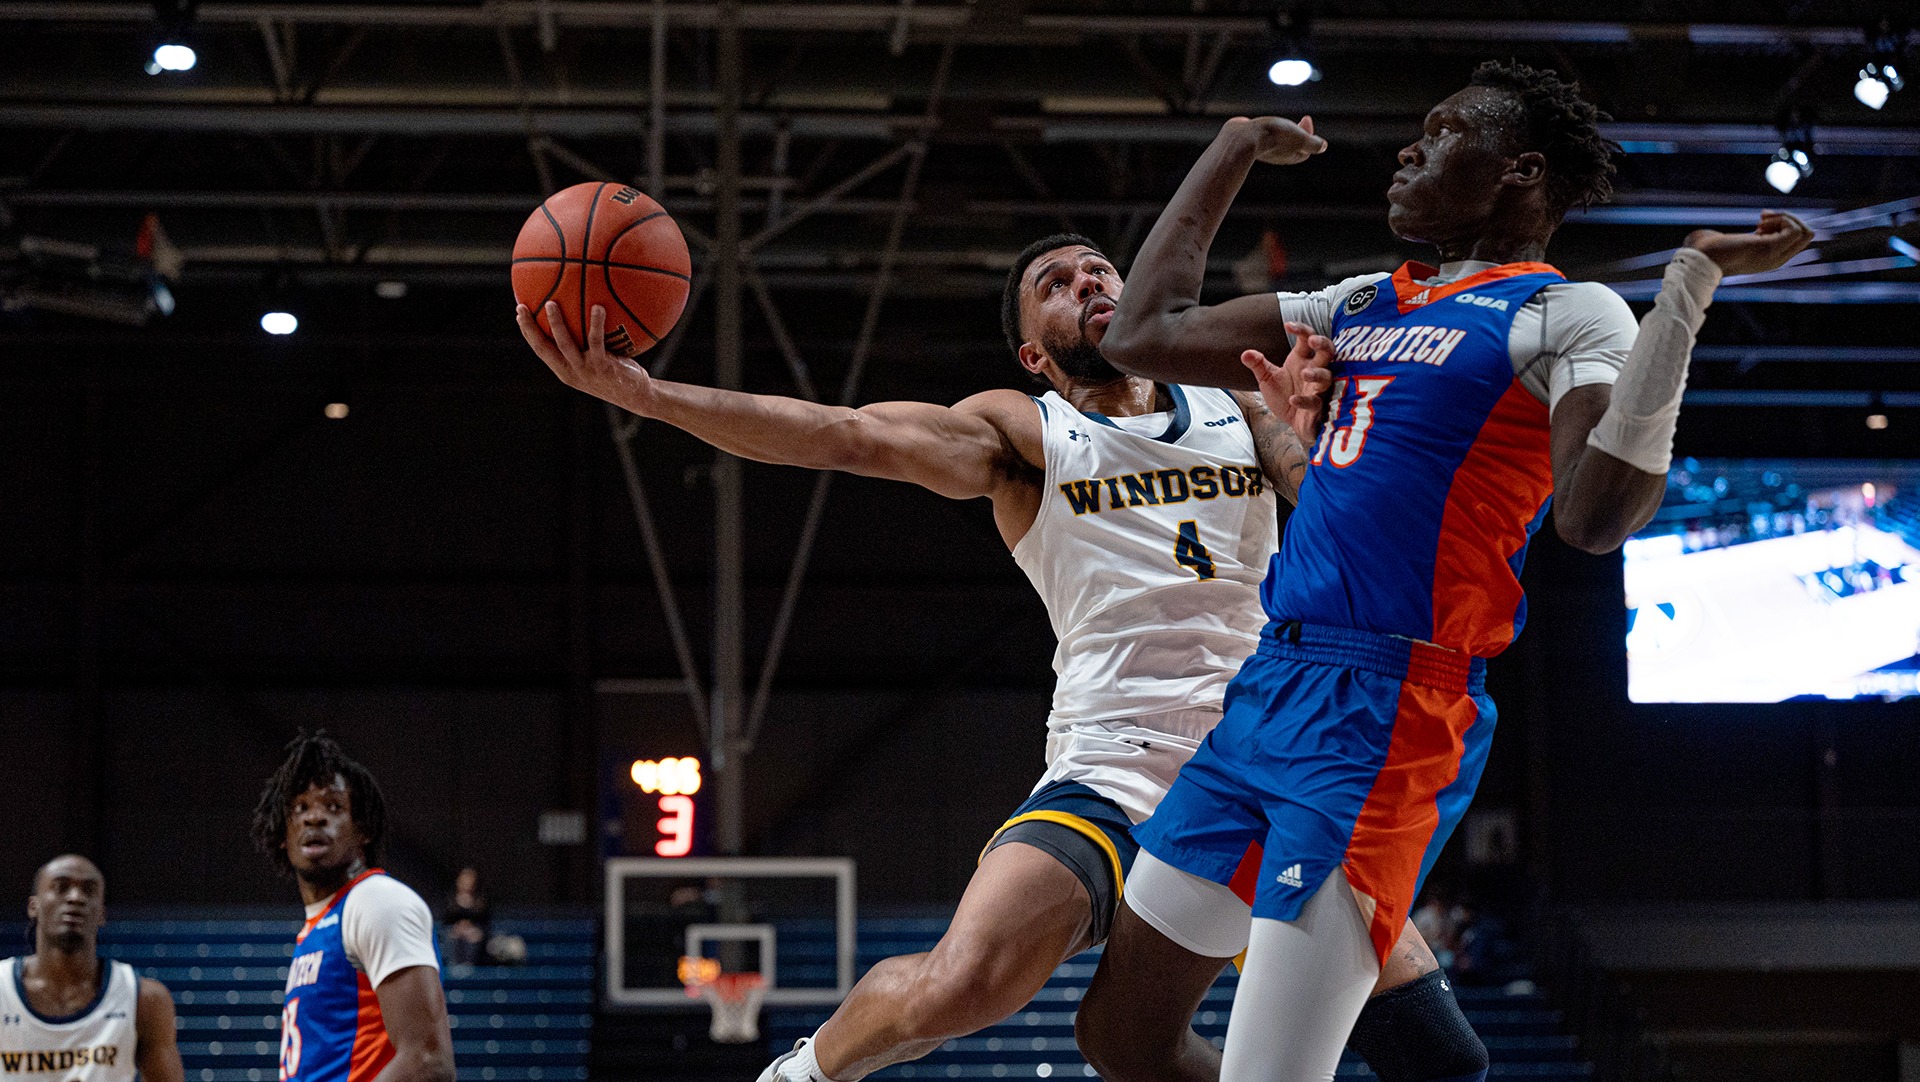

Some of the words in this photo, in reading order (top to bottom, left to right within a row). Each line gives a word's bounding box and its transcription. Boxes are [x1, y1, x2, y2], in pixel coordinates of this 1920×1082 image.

[1350, 290, 1374, 305] GF
[1454, 293, 1509, 312] OUA
[1387, 326, 1467, 366] TECH
[1203, 415, 1239, 427] OUA
[1310, 375, 1396, 469] 13
[1058, 465, 1264, 516] WINDSOR
[1173, 520, 1216, 582] 4
[655, 795, 694, 857] 3
[1, 1046, 117, 1072] WINDSOR
